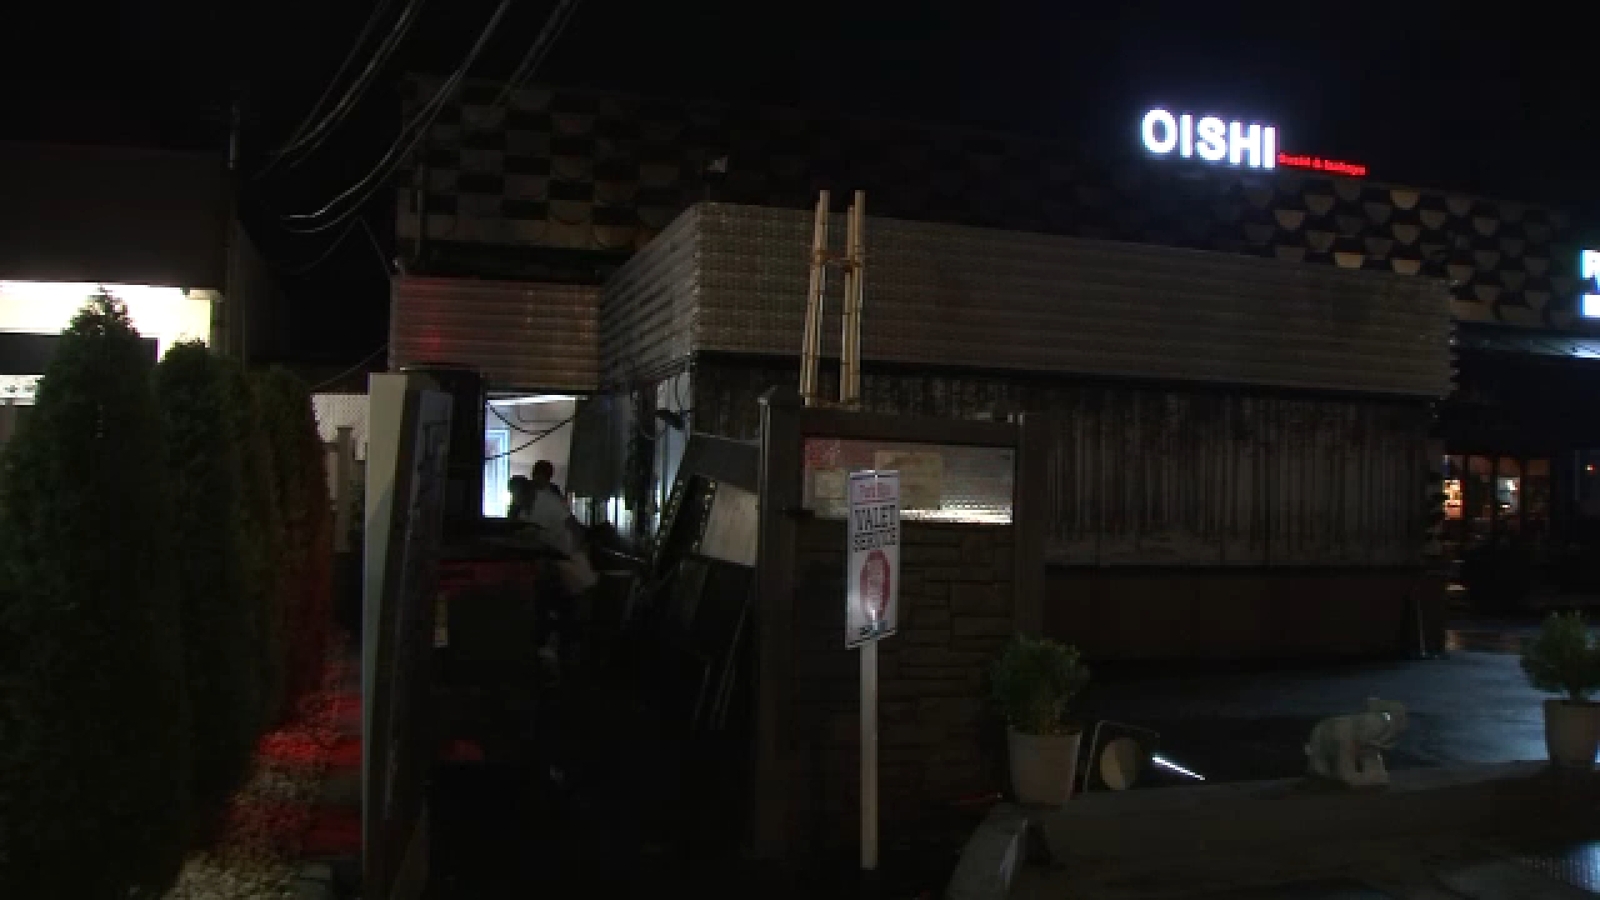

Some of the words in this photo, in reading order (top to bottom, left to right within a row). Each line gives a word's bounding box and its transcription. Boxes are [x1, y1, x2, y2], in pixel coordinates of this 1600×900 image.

[1141, 108, 1276, 169] OISHI
[854, 504, 896, 531] VALET
[854, 527, 896, 552] SERVICE
